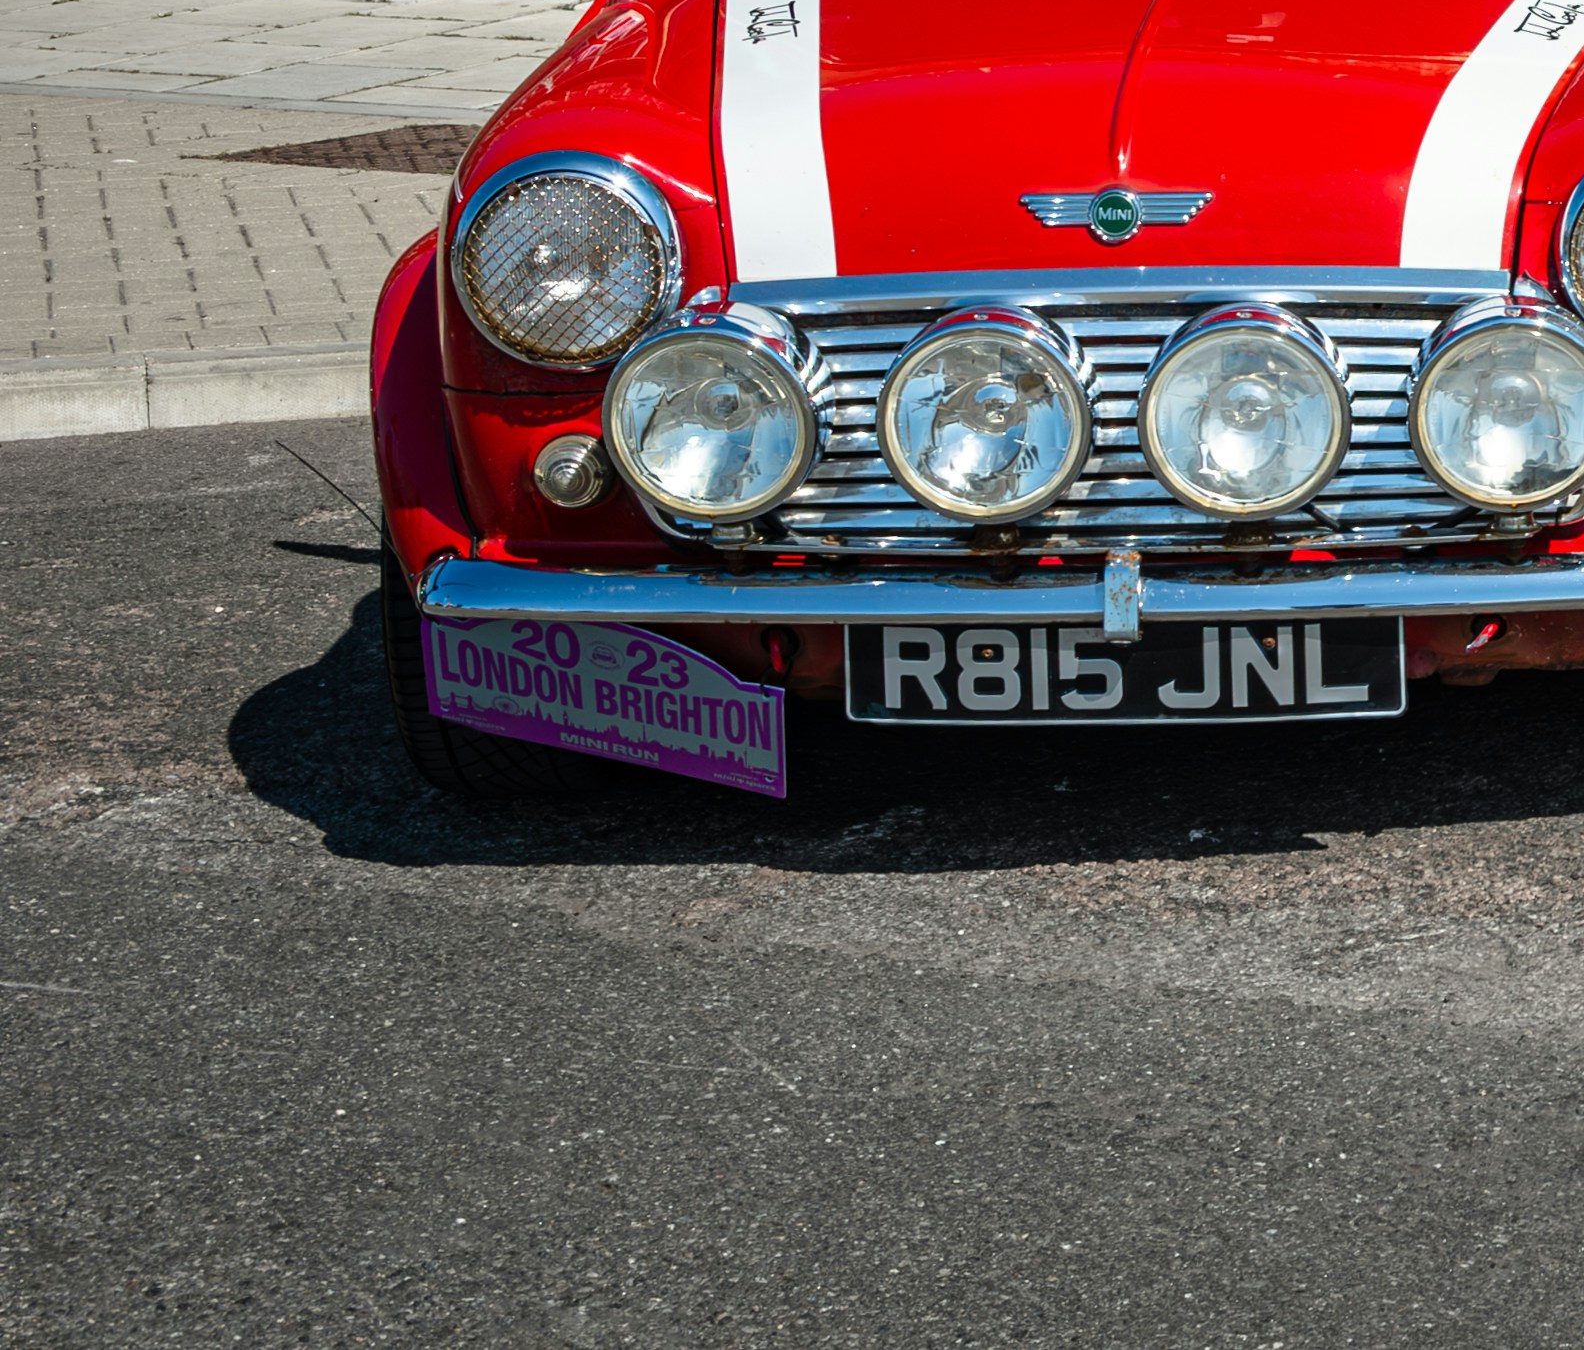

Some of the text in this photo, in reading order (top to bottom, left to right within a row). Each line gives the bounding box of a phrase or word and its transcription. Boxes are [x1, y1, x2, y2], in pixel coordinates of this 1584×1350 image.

[1098, 206, 1132, 221] MINI
[437, 628, 773, 752] LONDON BRIGHTON
[510, 619, 690, 691] 20 23
[883, 623, 1370, 712] R815 JNL
[559, 731, 609, 751] MINI
[612, 742, 661, 763] RUN
